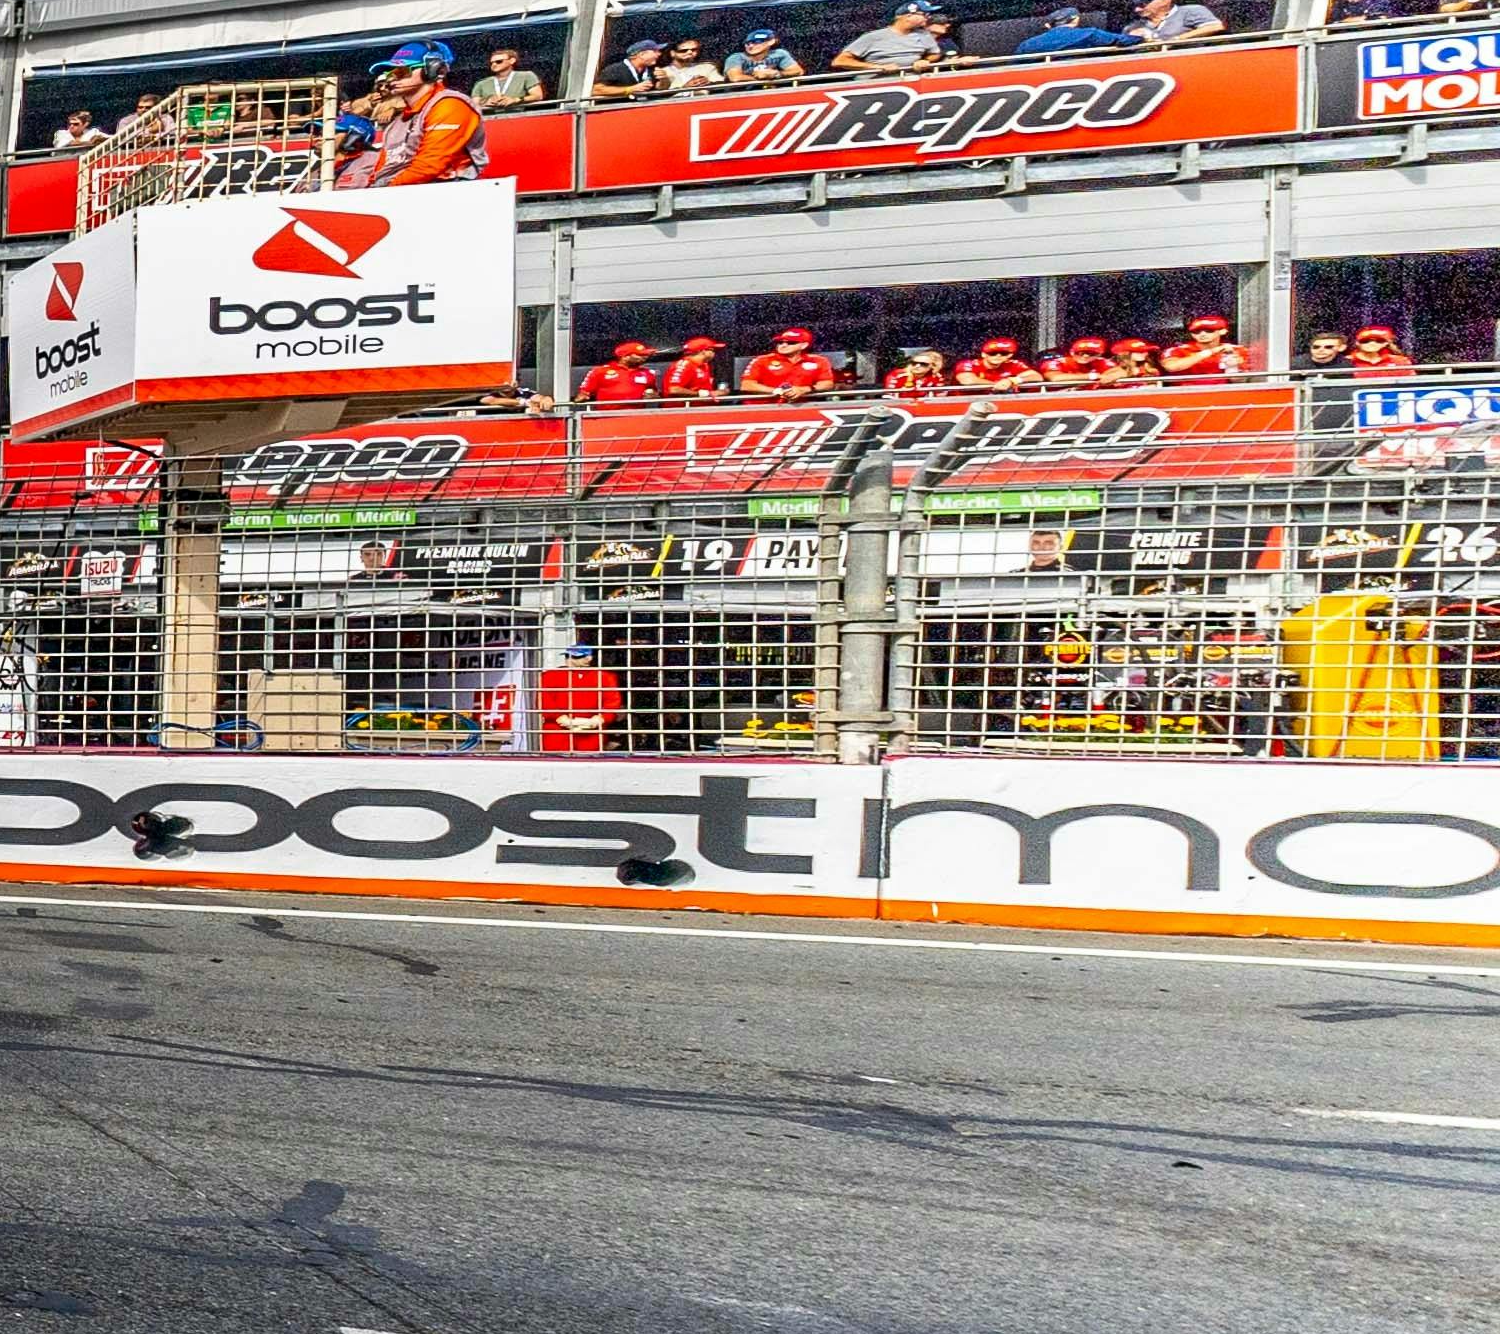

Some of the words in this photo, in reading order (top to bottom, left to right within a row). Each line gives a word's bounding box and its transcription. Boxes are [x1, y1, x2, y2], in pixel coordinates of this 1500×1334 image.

[810, 73, 1174, 153] Repco
[209, 284, 436, 335] boost
[34, 320, 102, 379] boost
[255, 334, 384, 360] mobile
[49, 369, 89, 398] mobile
[224, 435, 469, 495] epco
[680, 539, 734, 570] 19
[764, 539, 823, 570] PAY
[1420, 526, 1500, 566] 26
[84, 559, 118, 576] ISUZU
